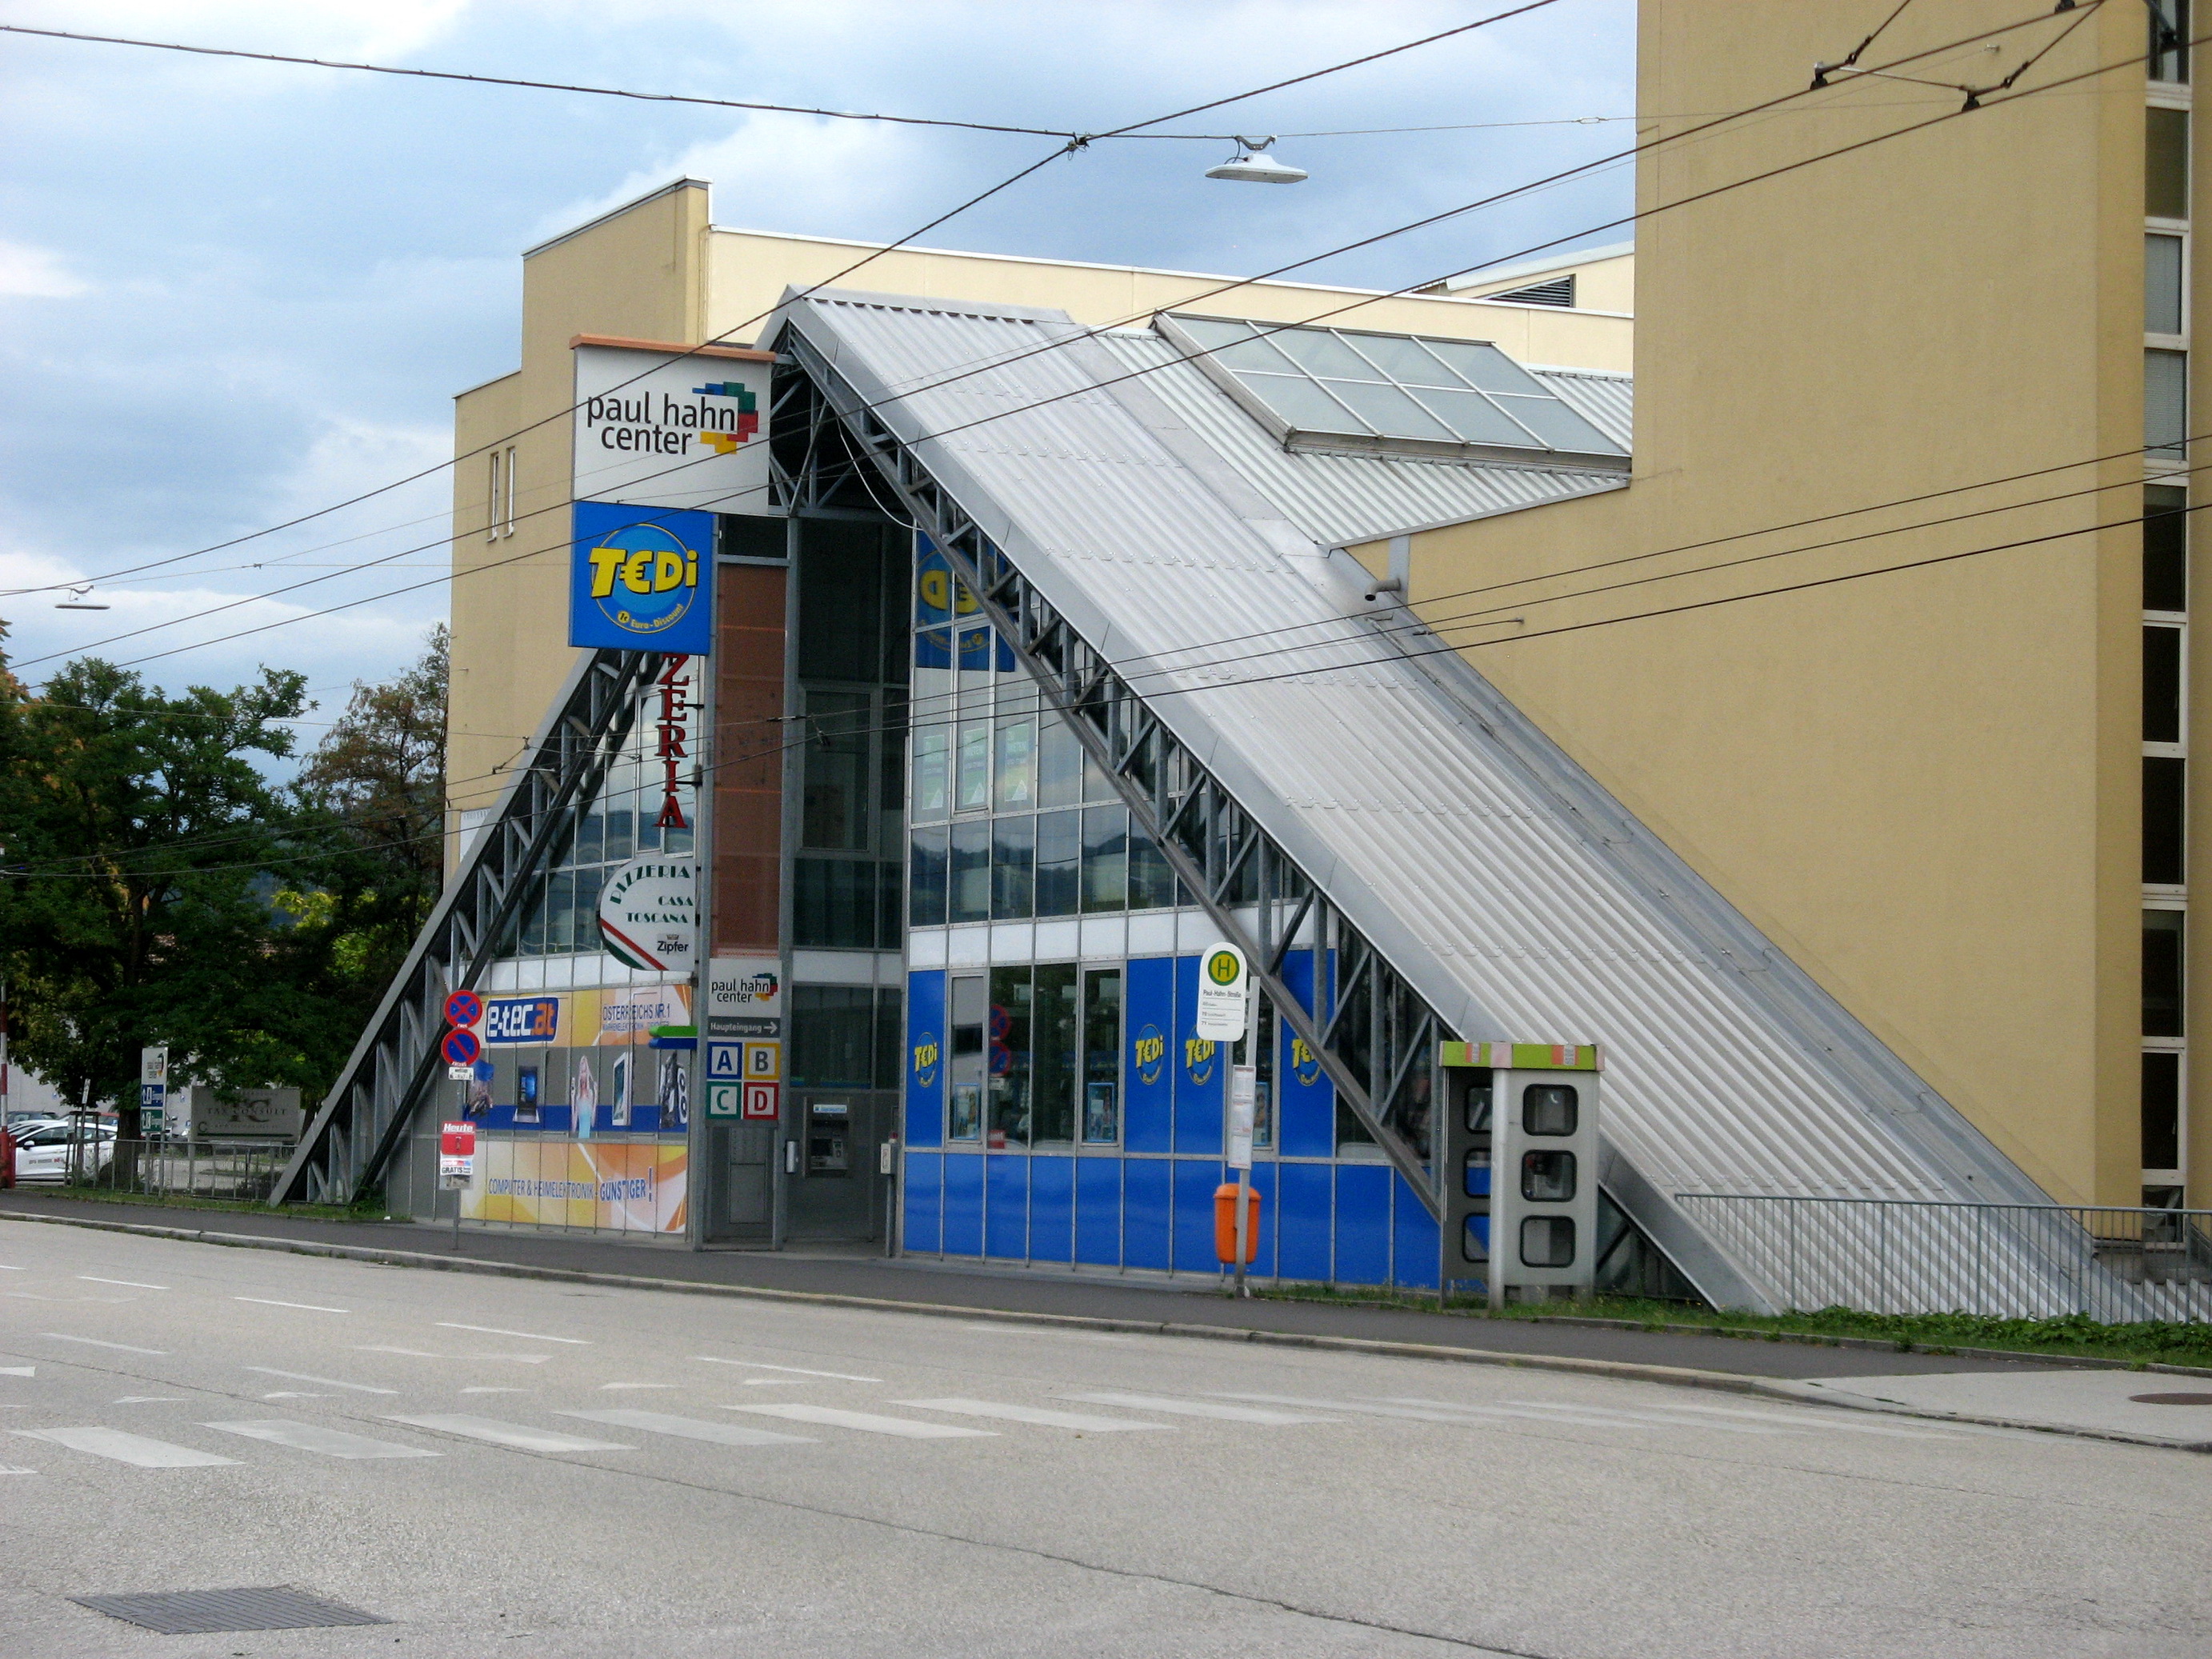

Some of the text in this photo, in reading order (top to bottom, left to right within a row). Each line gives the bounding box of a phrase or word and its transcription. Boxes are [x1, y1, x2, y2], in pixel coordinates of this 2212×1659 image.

[587, 391, 736, 431] paul hahn
[601, 423, 692, 455] center
[610, 865, 690, 905] PIZZERIA
[658, 896, 694, 906] CASA
[626, 912, 688, 924] TOSCANA
[657, 940, 689, 955] Zipfer
[1218, 958, 1230, 977] H
[710, 977, 770, 994] paul hahn
[716, 992, 753, 1003] center
[710, 1022, 762, 1034] Haupteingang
[716, 1049, 769, 1072] A B
[716, 1089, 768, 1112] C D
[443, 1122, 474, 1133] Heute
[489, 1178, 525, 1196] COMPUTER
[526, 1180, 532, 1197] &
